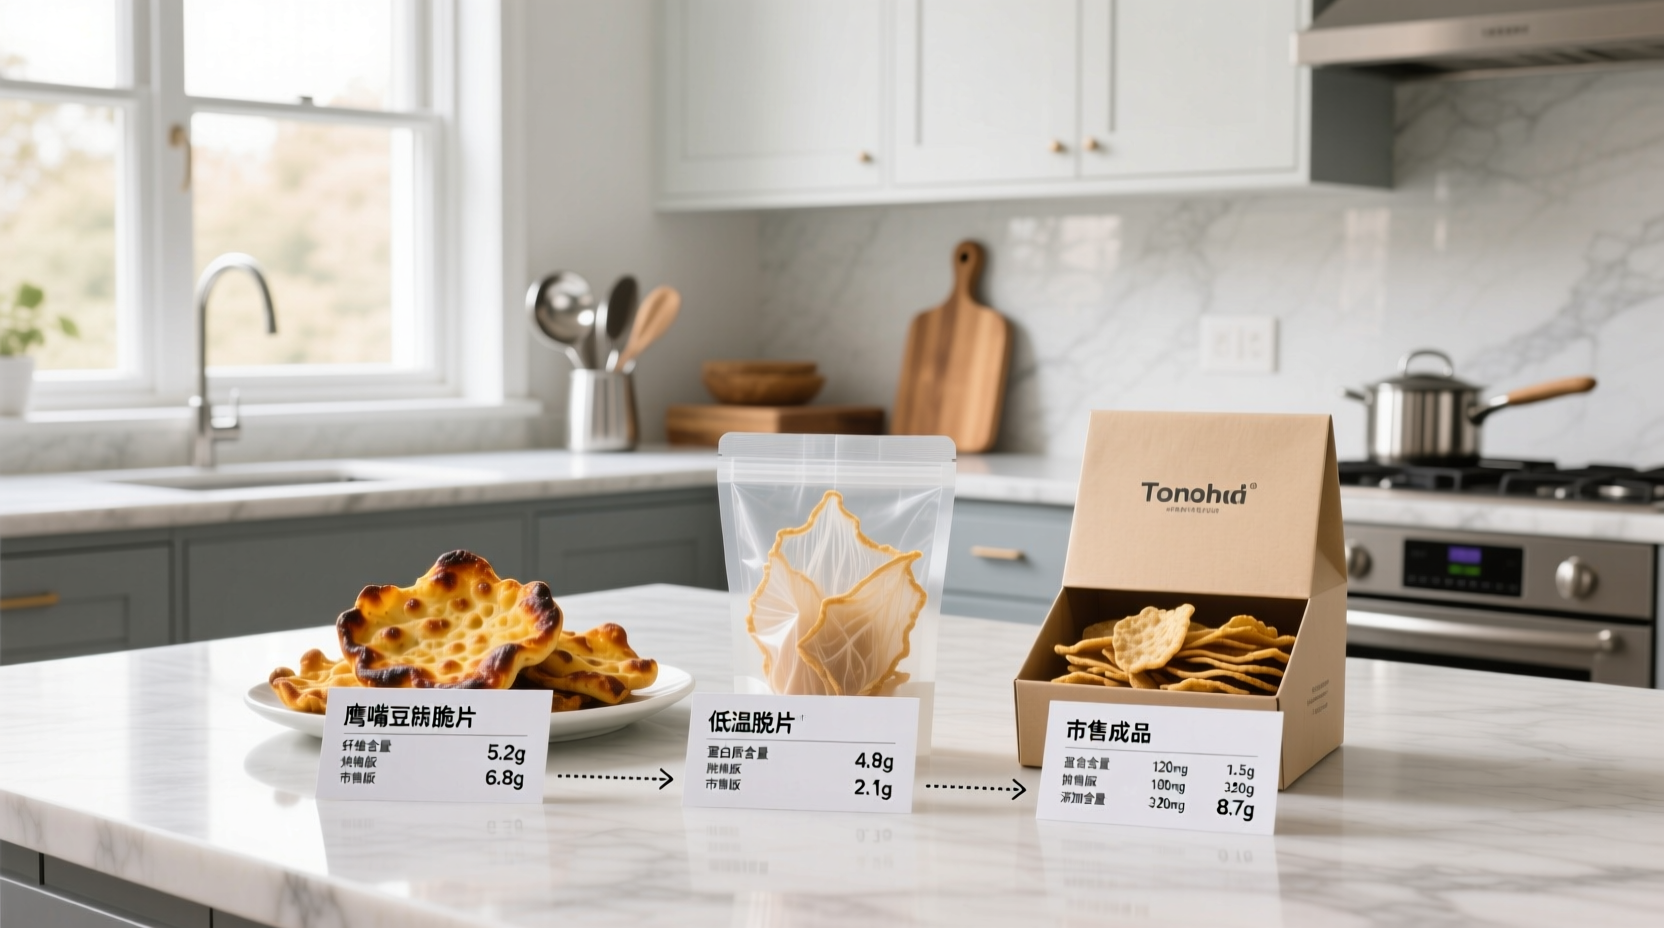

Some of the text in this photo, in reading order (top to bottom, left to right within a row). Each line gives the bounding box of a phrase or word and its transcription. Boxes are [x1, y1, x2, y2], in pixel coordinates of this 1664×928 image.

[1066, 719, 1152, 744] 市售成品
[487, 744, 526, 765] 5.2g
[855, 752, 894, 773] 4.8g
[485, 769, 525, 790] 6.8g
[1226, 764, 1255, 780] 1.5g
[854, 779, 893, 800] 2.1g
[1216, 798, 1255, 822] 8.7g
